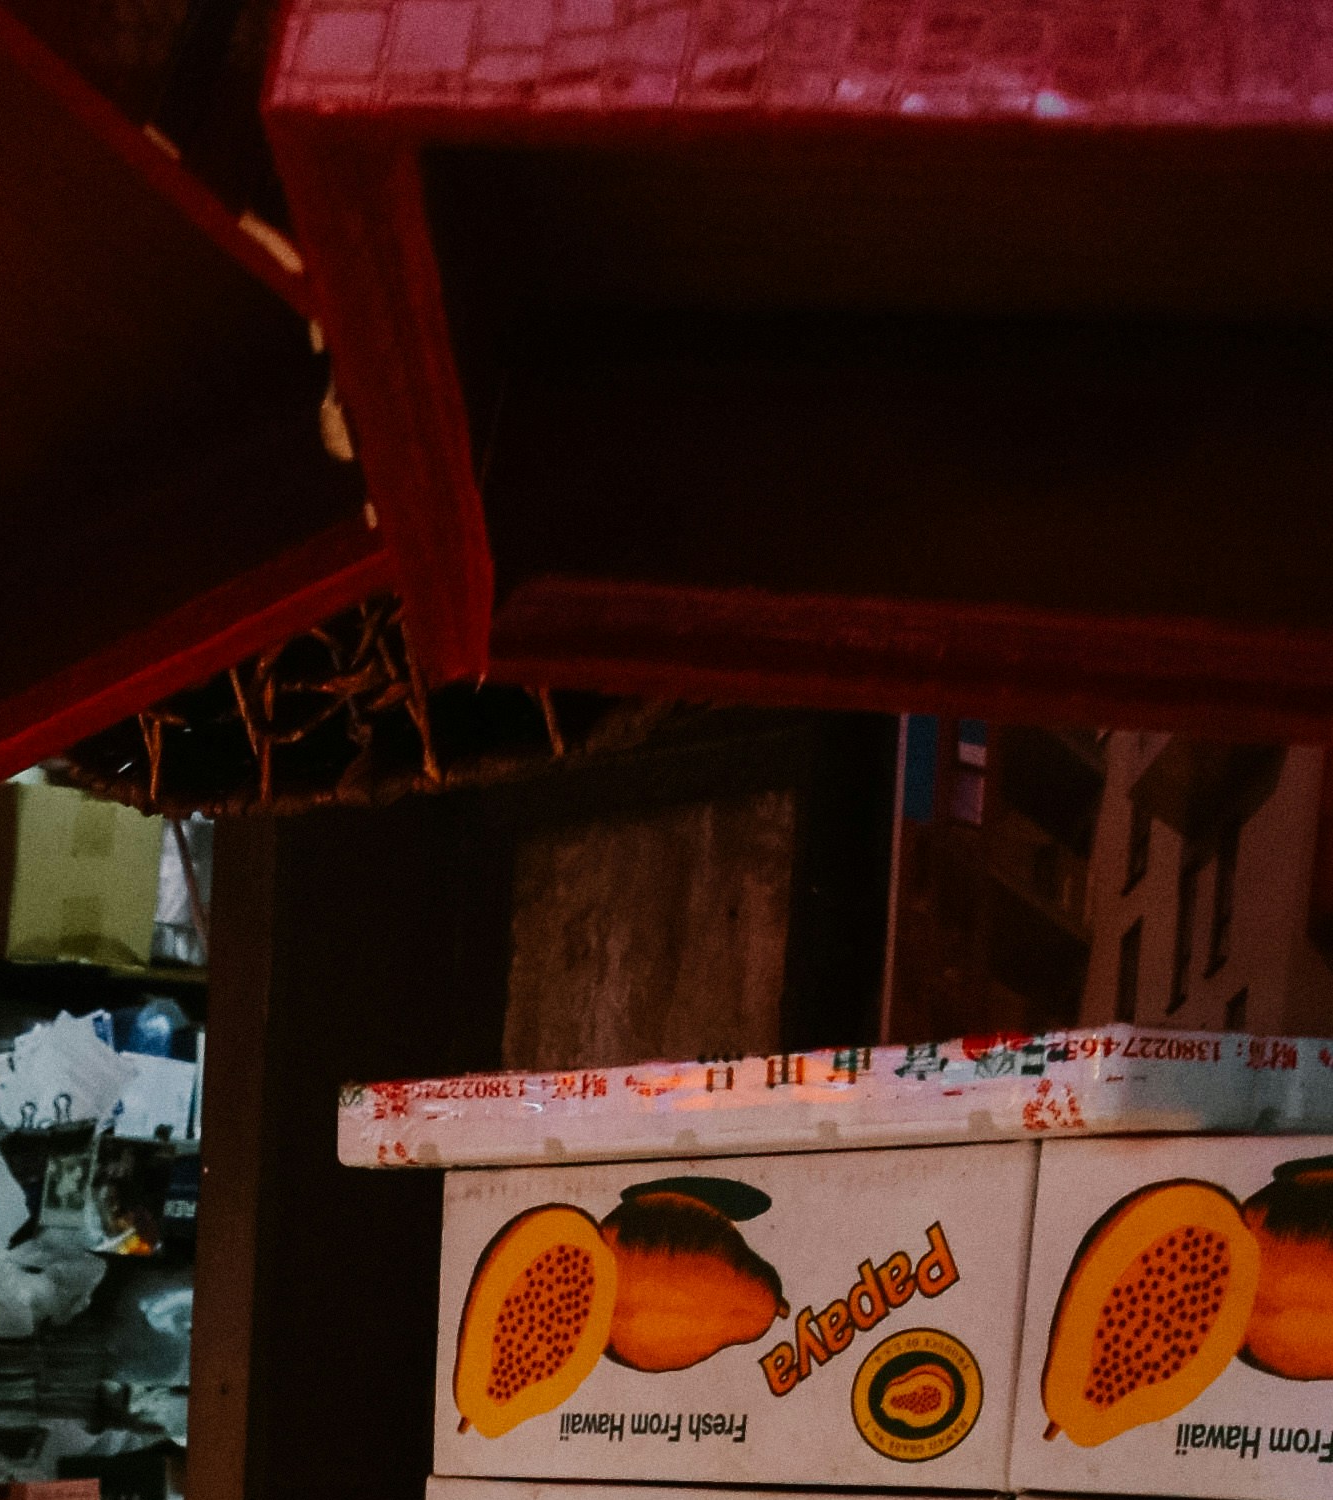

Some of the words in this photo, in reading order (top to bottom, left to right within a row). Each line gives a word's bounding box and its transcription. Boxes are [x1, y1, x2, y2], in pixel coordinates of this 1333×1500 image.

[759, 1220, 961, 1397] Papaya
[559, 1412, 626, 1442] Hawaii
[630, 1412, 683, 1443] From
[687, 1412, 748, 1443] Fresh
[1175, 1423, 1263, 1460] Hawaii
